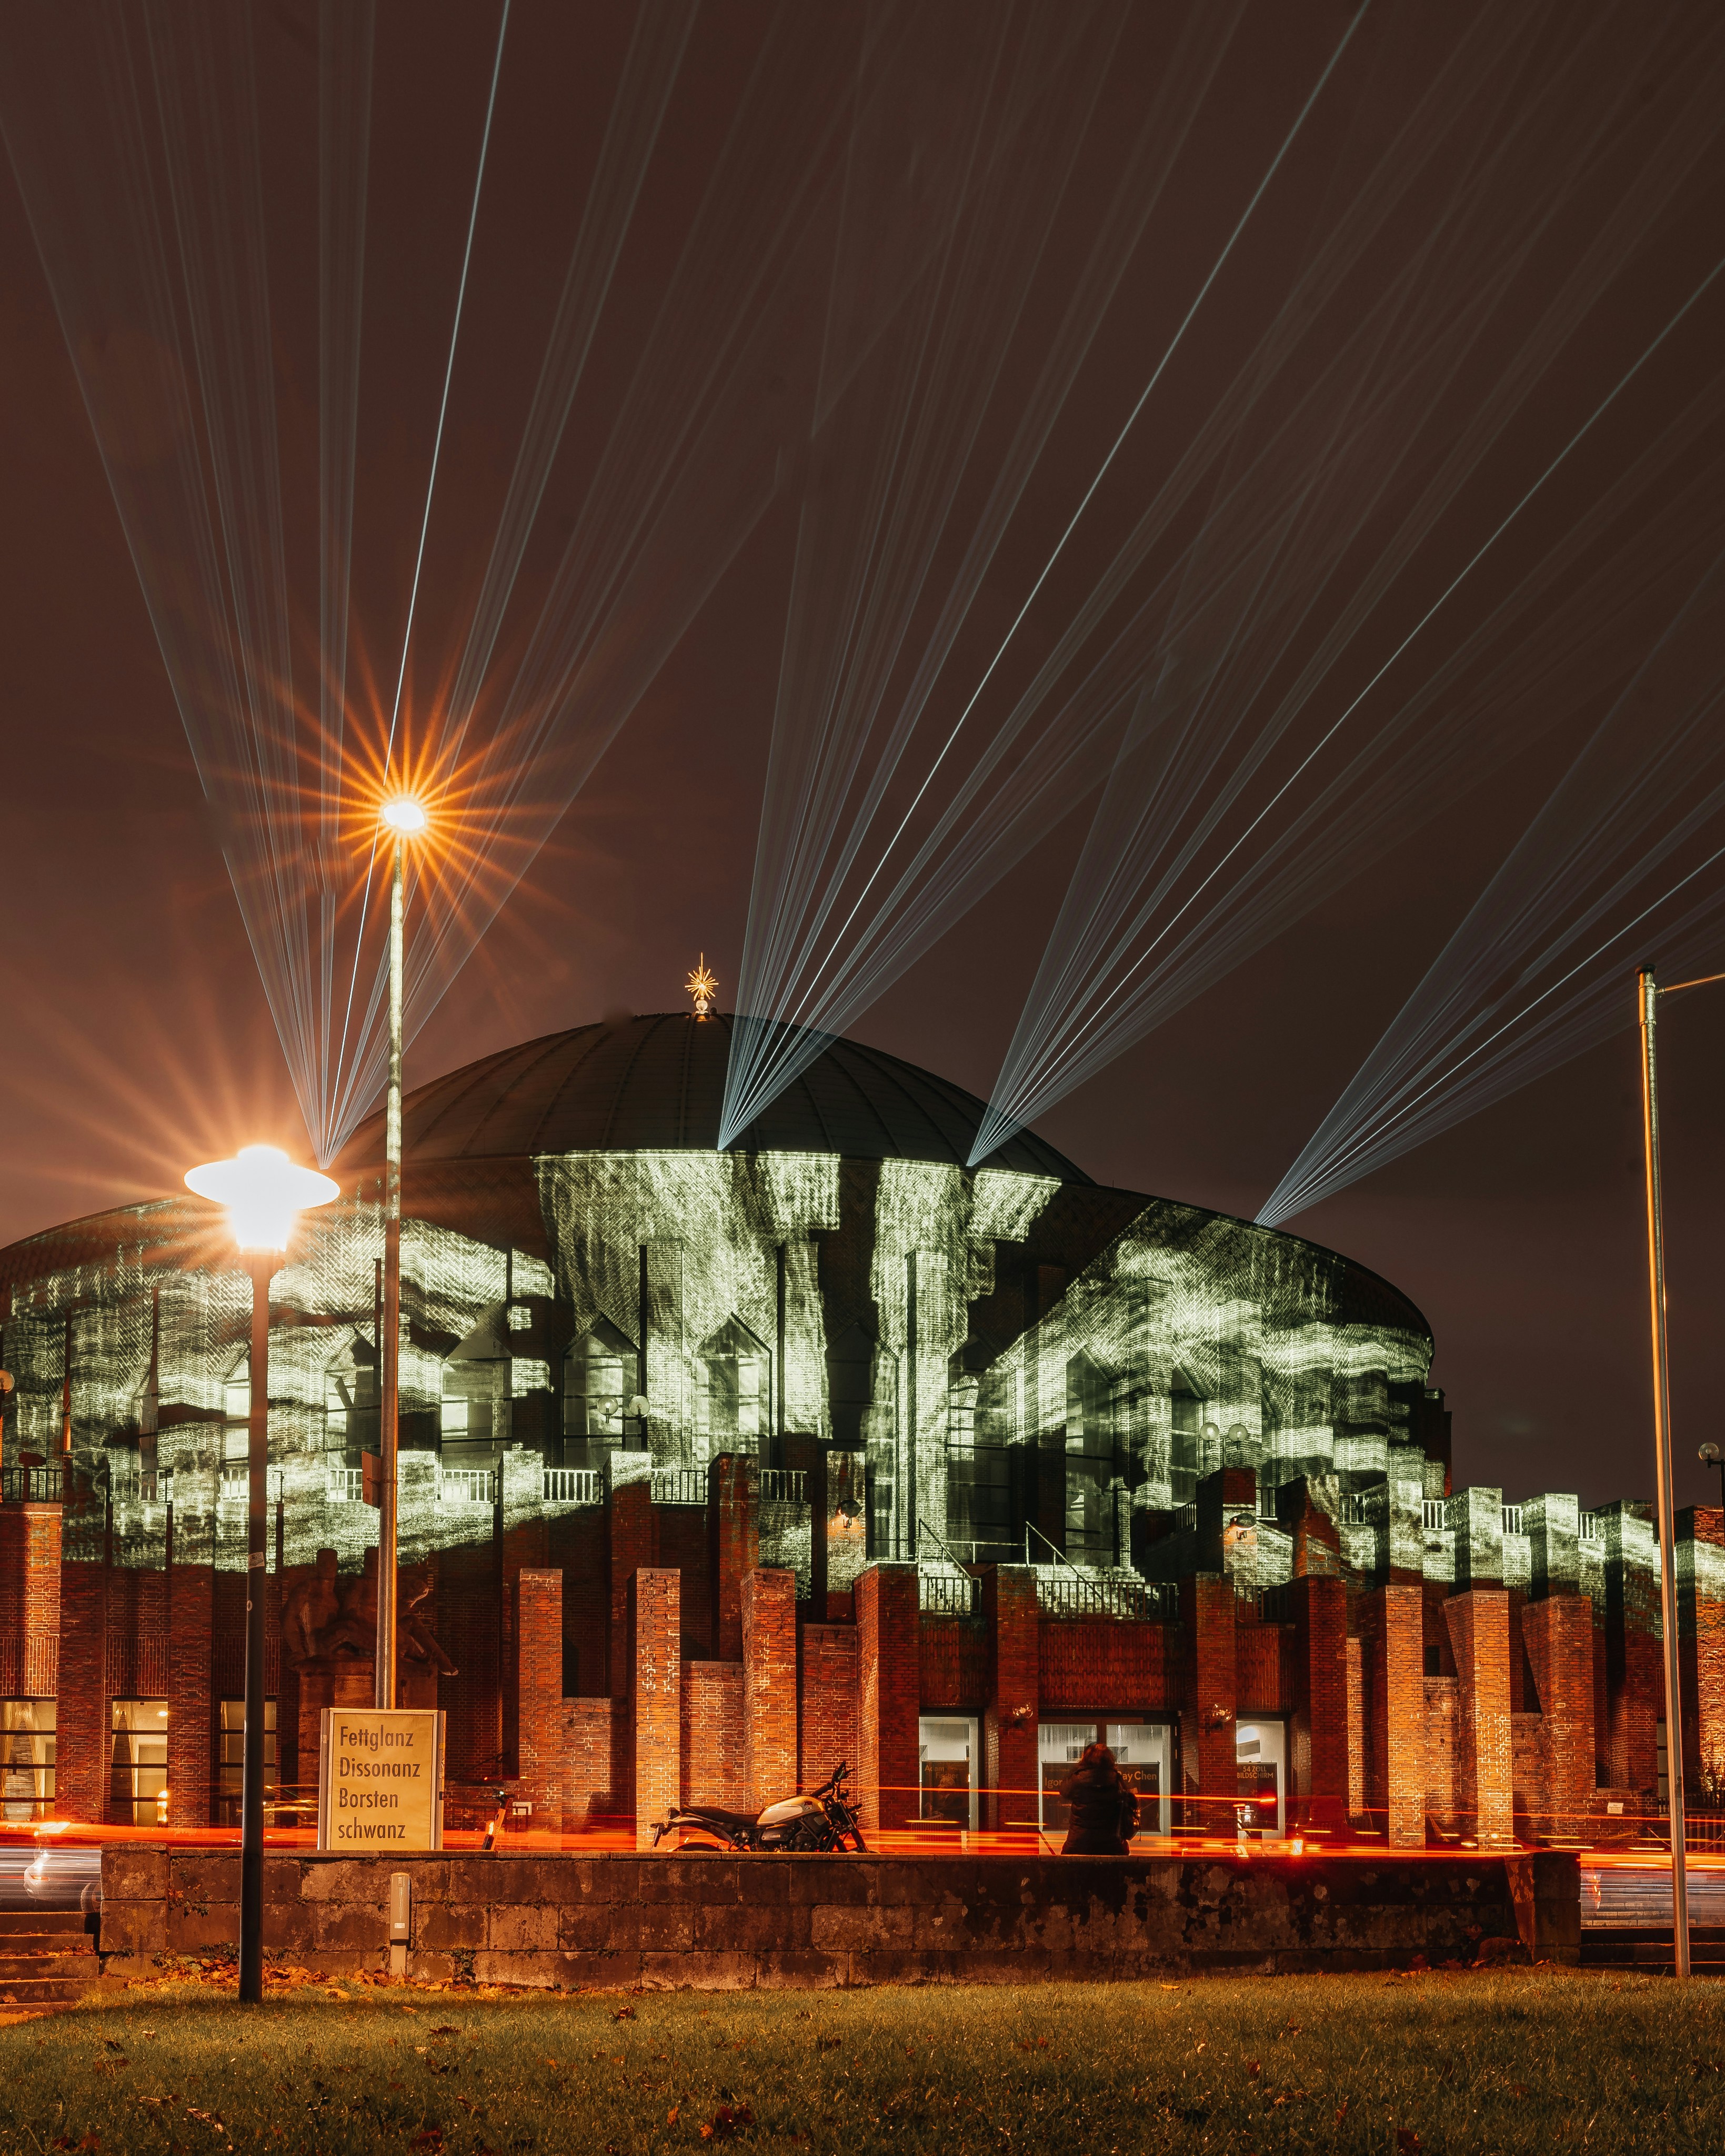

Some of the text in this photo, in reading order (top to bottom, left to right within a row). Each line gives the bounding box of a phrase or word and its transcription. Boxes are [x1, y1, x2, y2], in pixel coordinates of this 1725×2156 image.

[340, 1724, 414, 1752] Fettglanz
[339, 1757, 421, 1778] Dissonanz
[1134, 1770, 1157, 1780] Chen
[1045, 1777, 1063, 1789] Igor
[339, 1787, 398, 1808] Borsten
[338, 1817, 406, 1839] schwanz
